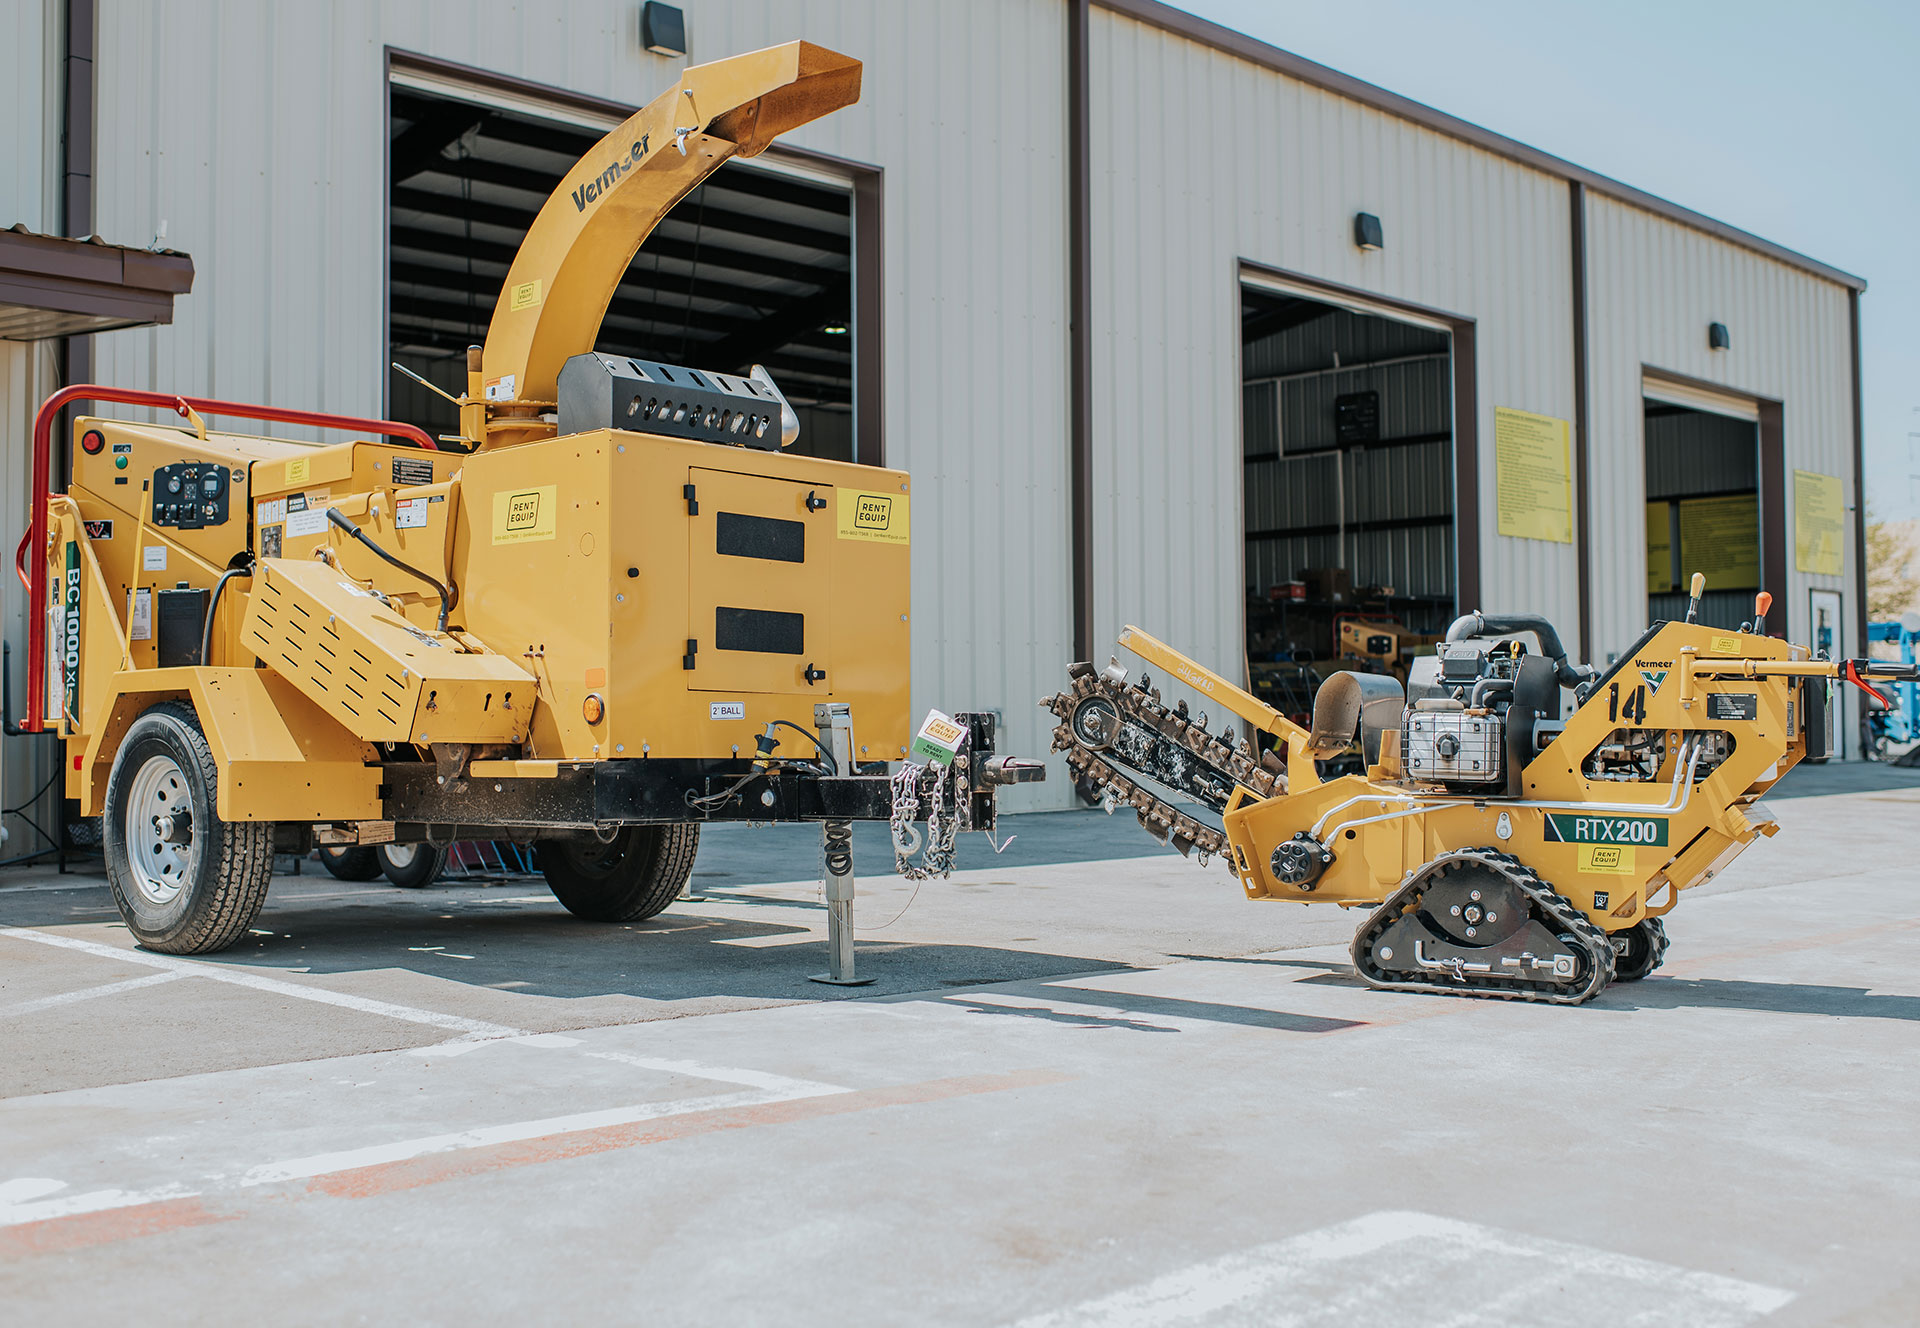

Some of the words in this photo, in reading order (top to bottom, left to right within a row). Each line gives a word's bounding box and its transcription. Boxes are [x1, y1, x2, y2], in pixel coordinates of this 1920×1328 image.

[513, 501, 535, 511] RENT
[862, 503, 886, 512] RENT
[510, 512, 535, 522] EQUIP
[859, 512, 886, 522] EQUIP
[1635, 659, 1673, 668] Vermeer
[1608, 682, 1647, 725] 14
[721, 706, 741, 715] BALL
[926, 744, 943, 753] READY
[929, 750, 943, 759] RENT
[1575, 818, 1657, 843] RTX200
